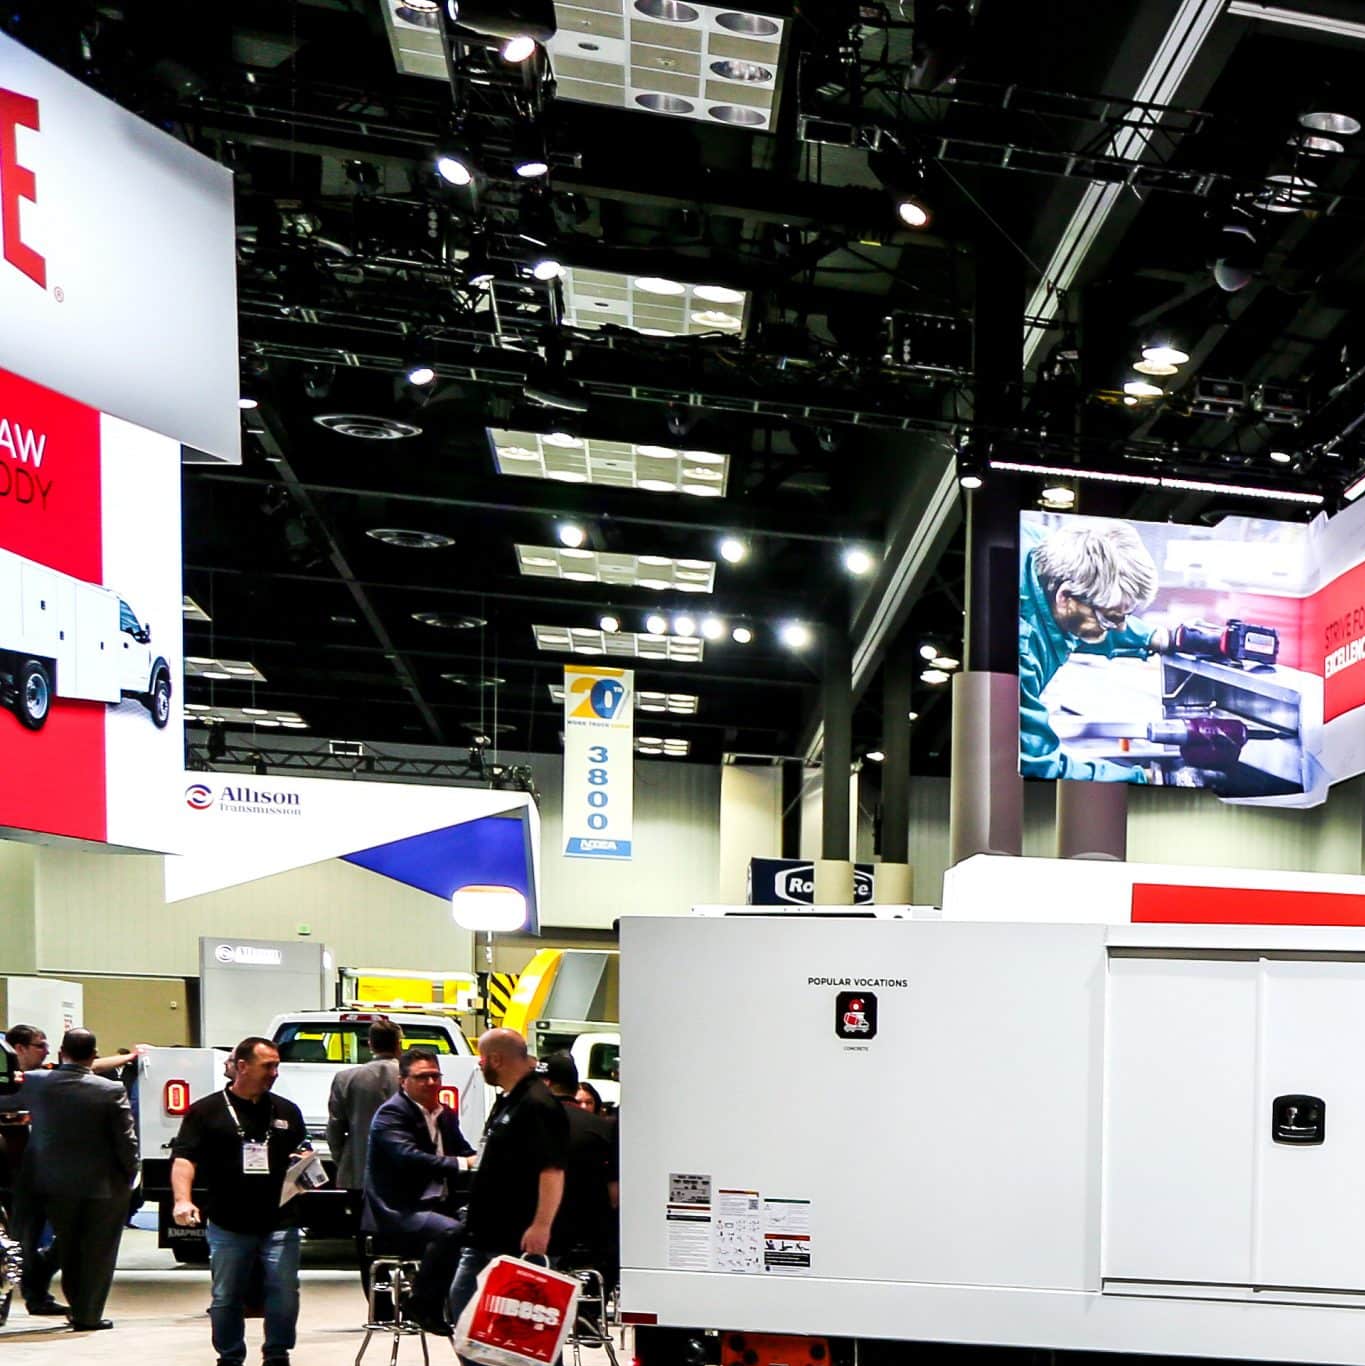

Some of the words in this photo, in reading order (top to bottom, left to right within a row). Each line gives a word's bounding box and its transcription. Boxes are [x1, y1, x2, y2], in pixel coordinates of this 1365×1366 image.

[220, 786, 300, 806] Allison
[587, 746, 609, 831] 3800
[220, 803, 302, 816] Transmission
[808, 977, 851, 986] POPULAR
[854, 979, 908, 988] VOCATIONS
